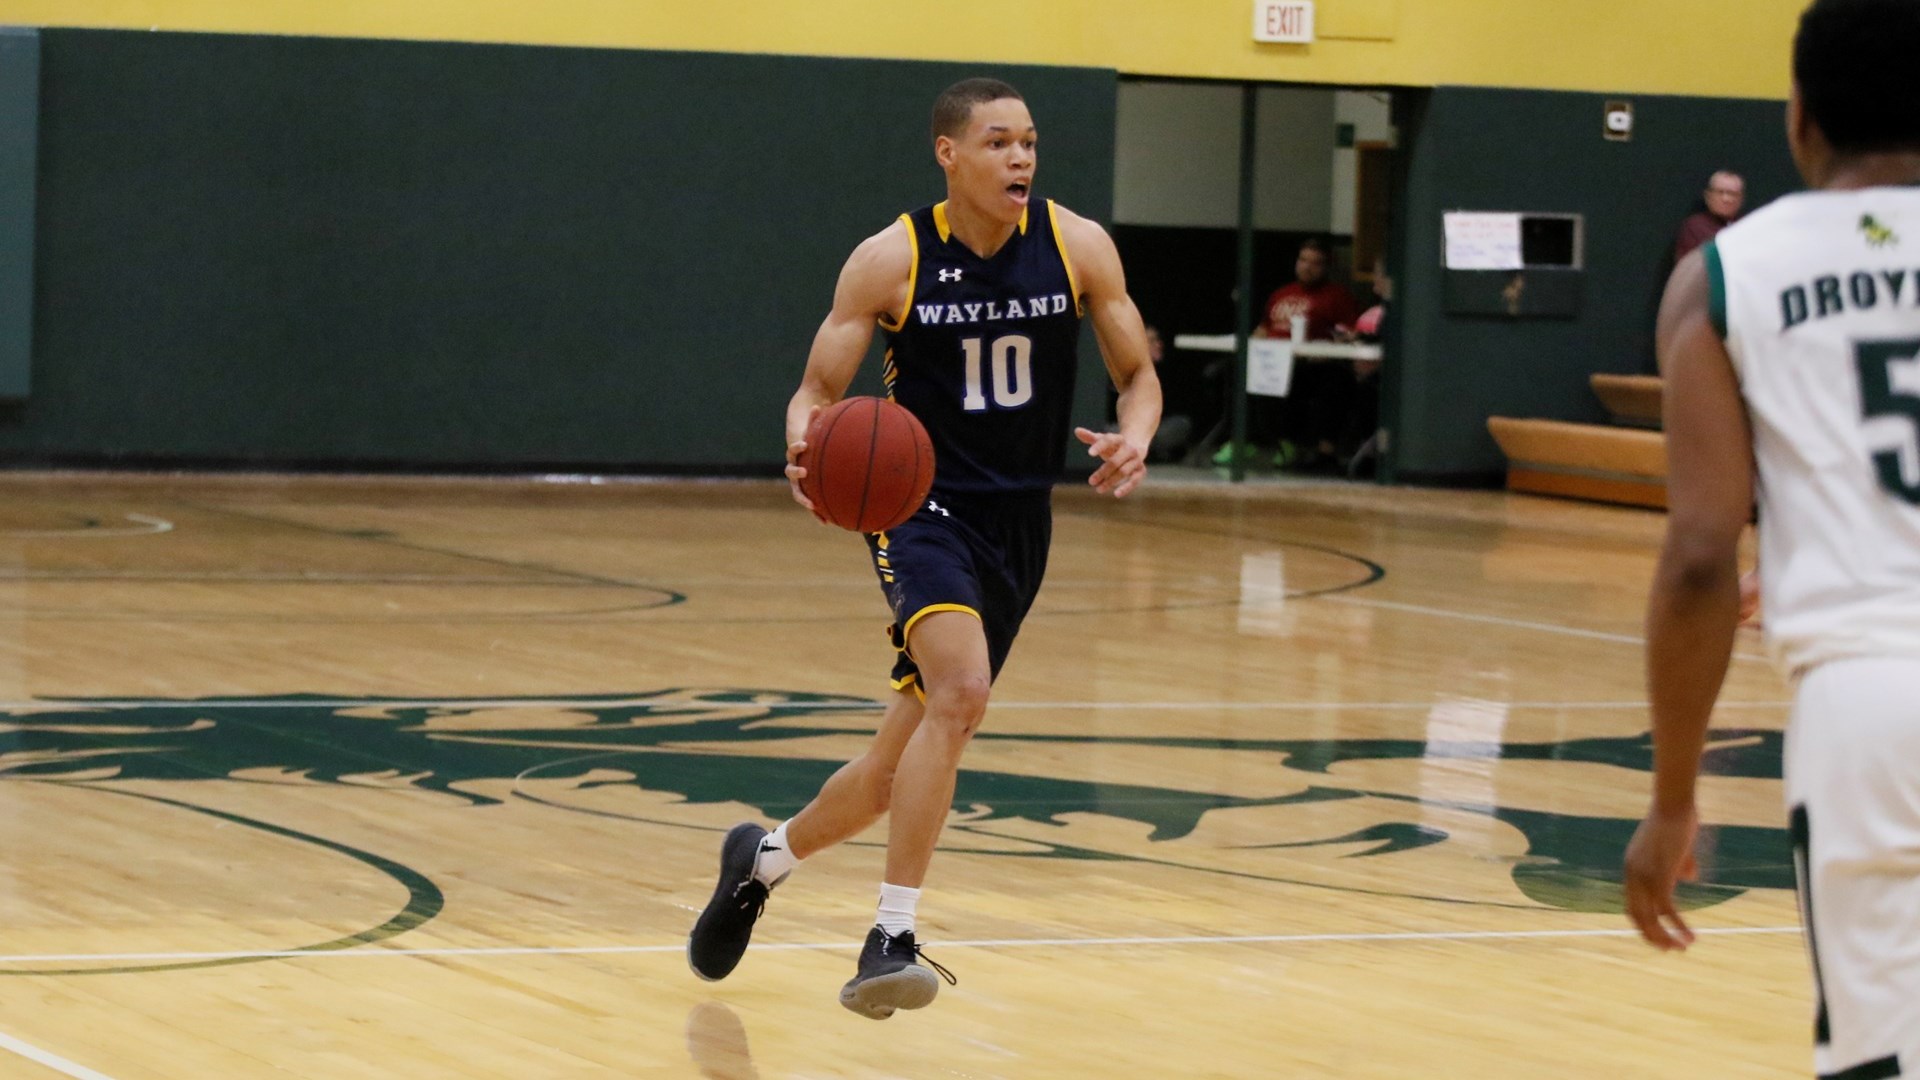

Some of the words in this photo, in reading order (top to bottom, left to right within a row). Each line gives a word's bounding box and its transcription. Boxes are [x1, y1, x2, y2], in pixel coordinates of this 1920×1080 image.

[1266, 6, 1304, 35] EXIT
[917, 294, 1067, 324] WAYLAND
[1780, 269, 1920, 328] DROV
[962, 335, 1032, 410] 10
[1855, 339, 1920, 506] 5
